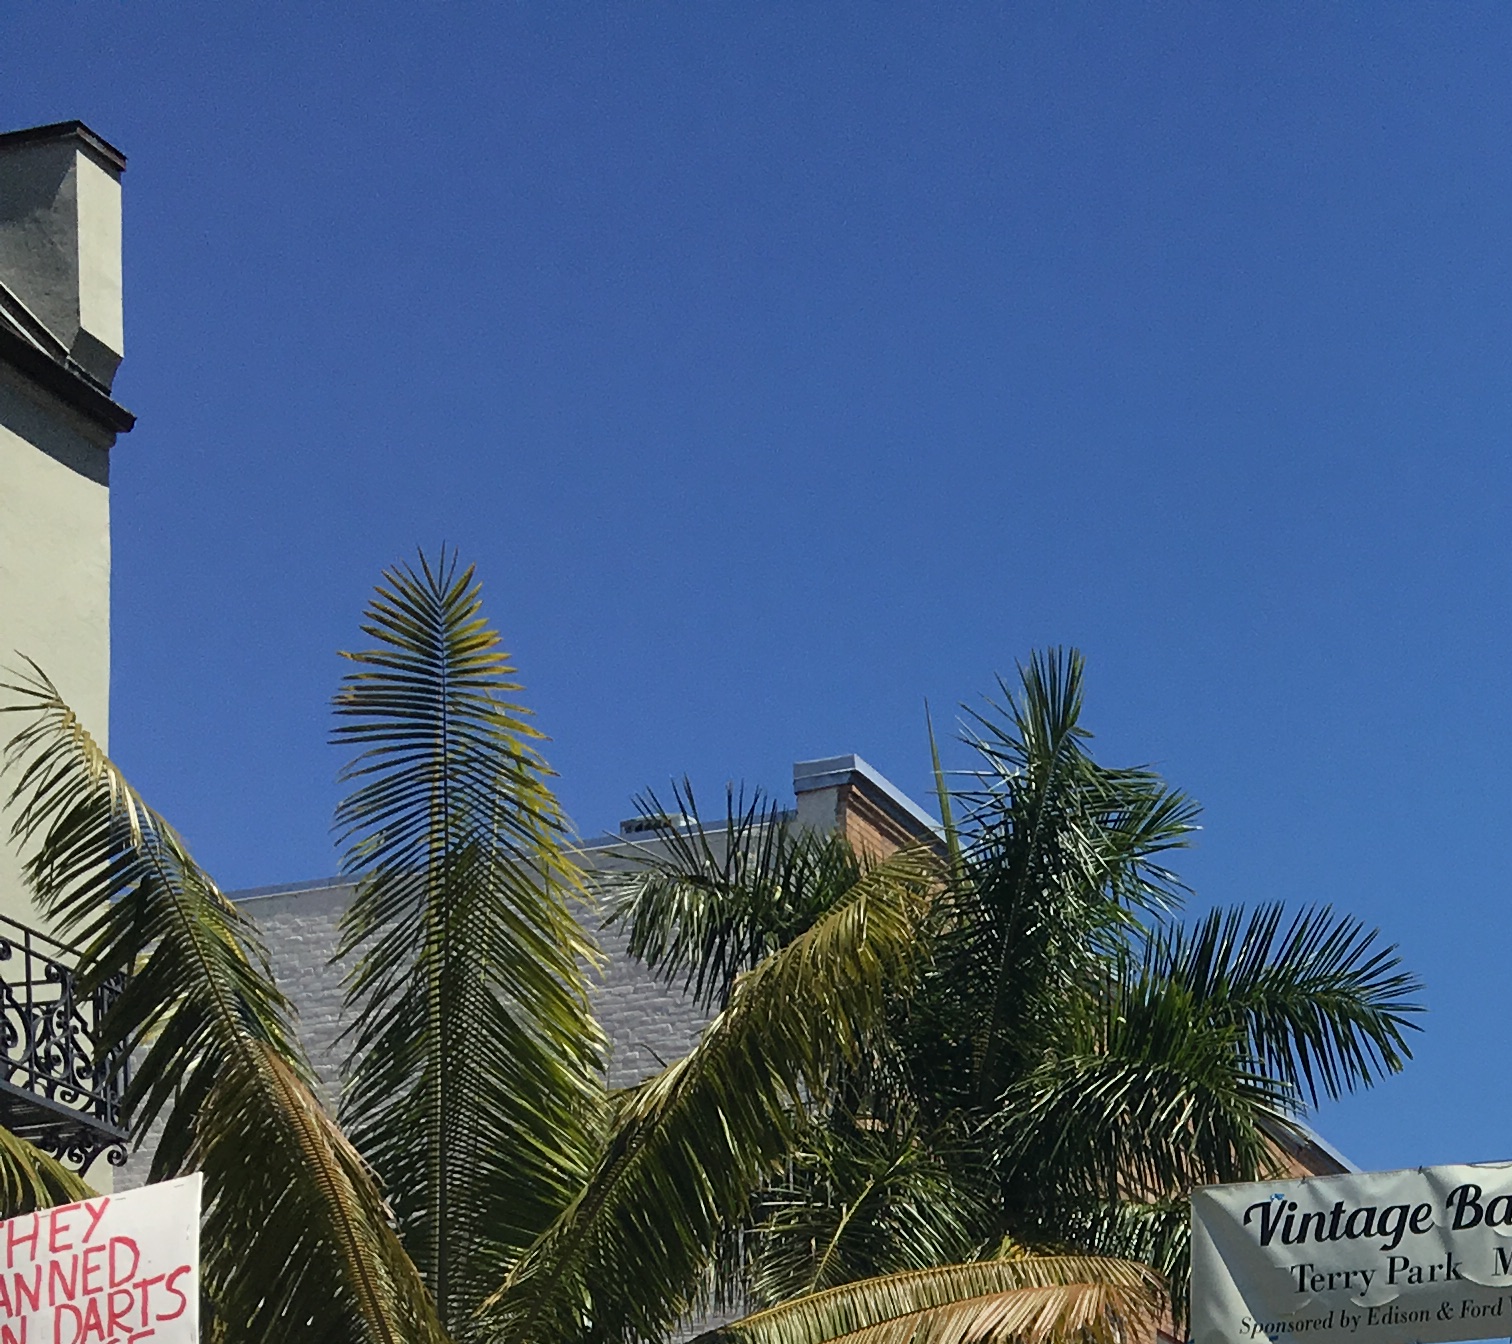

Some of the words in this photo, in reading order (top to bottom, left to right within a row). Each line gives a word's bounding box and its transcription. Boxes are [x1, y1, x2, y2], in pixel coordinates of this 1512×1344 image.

[0, 1197, 110, 1269] HEY
[1244, 1198, 1436, 1252] Vintage
[0, 1236, 140, 1318] ANNED
[1290, 1263, 1376, 1297] Terry
[1386, 1251, 1463, 1286] Park
[1239, 1309, 1334, 1339] Sponsored
[1340, 1310, 1362, 1332] by
[1367, 1301, 1430, 1326] Edison
[1436, 1301, 1453, 1321] &
[1459, 1295, 1503, 1319] Ford
